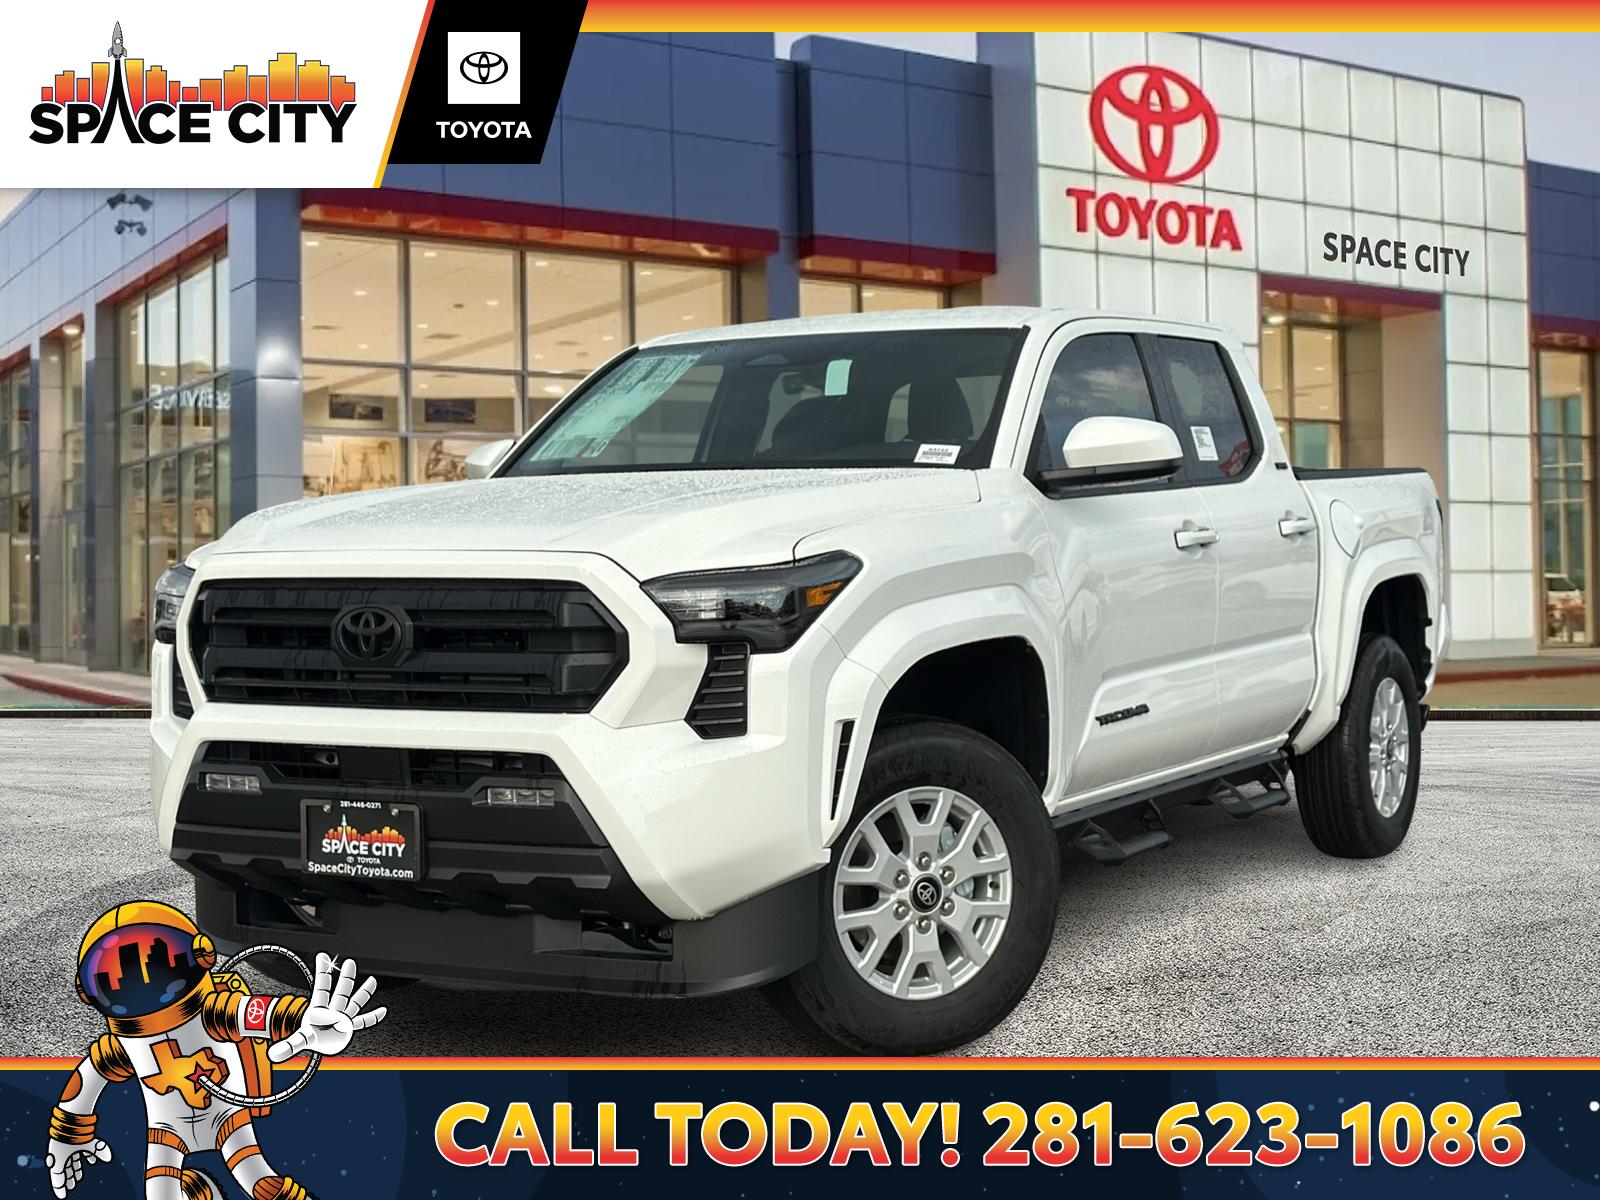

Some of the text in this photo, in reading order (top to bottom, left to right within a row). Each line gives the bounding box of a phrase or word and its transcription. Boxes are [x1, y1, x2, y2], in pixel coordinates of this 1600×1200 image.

[1066, 187, 1242, 251] TOYOTA
[1323, 232, 1470, 277] SPACE CITY
[321, 838, 405, 857] SPACE CITY
[307, 861, 414, 879] SpaceCityToyota.com
[356, 856, 381, 865] TOYOTA
